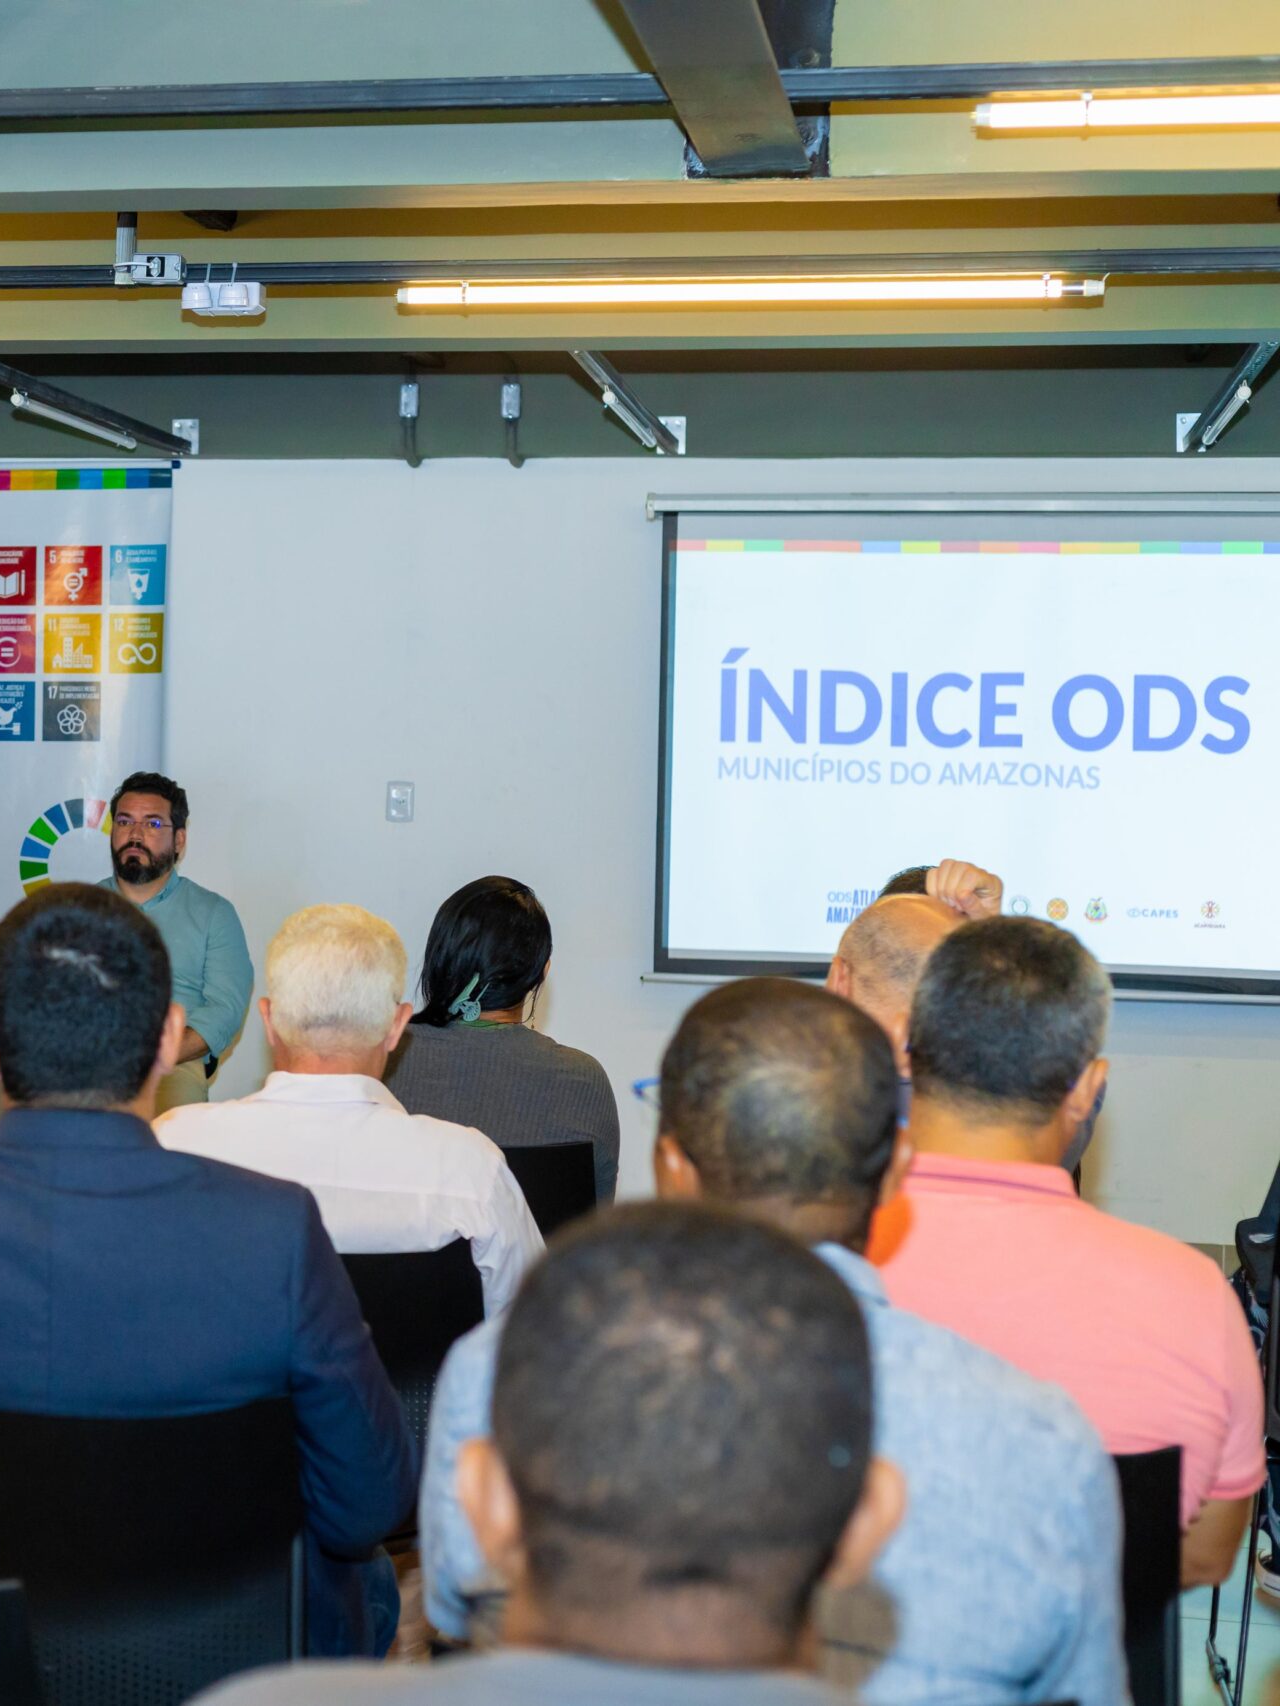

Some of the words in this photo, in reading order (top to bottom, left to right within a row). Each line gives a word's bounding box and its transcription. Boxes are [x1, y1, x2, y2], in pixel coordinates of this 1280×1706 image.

[49, 550, 57, 564] 5
[115, 549, 123, 563] 6
[48, 618, 57, 632] 11
[113, 618, 124, 632] 12
[48, 686, 58, 699] 17
[719, 647, 1025, 748] ÍNDICE
[1051, 673, 1251, 754] ODS
[716, 753, 881, 784] MUNICÍPIOS
[890, 761, 932, 785] DO
[938, 762, 1101, 790] AMAZONAS
[1142, 908, 1179, 918] CAPES
